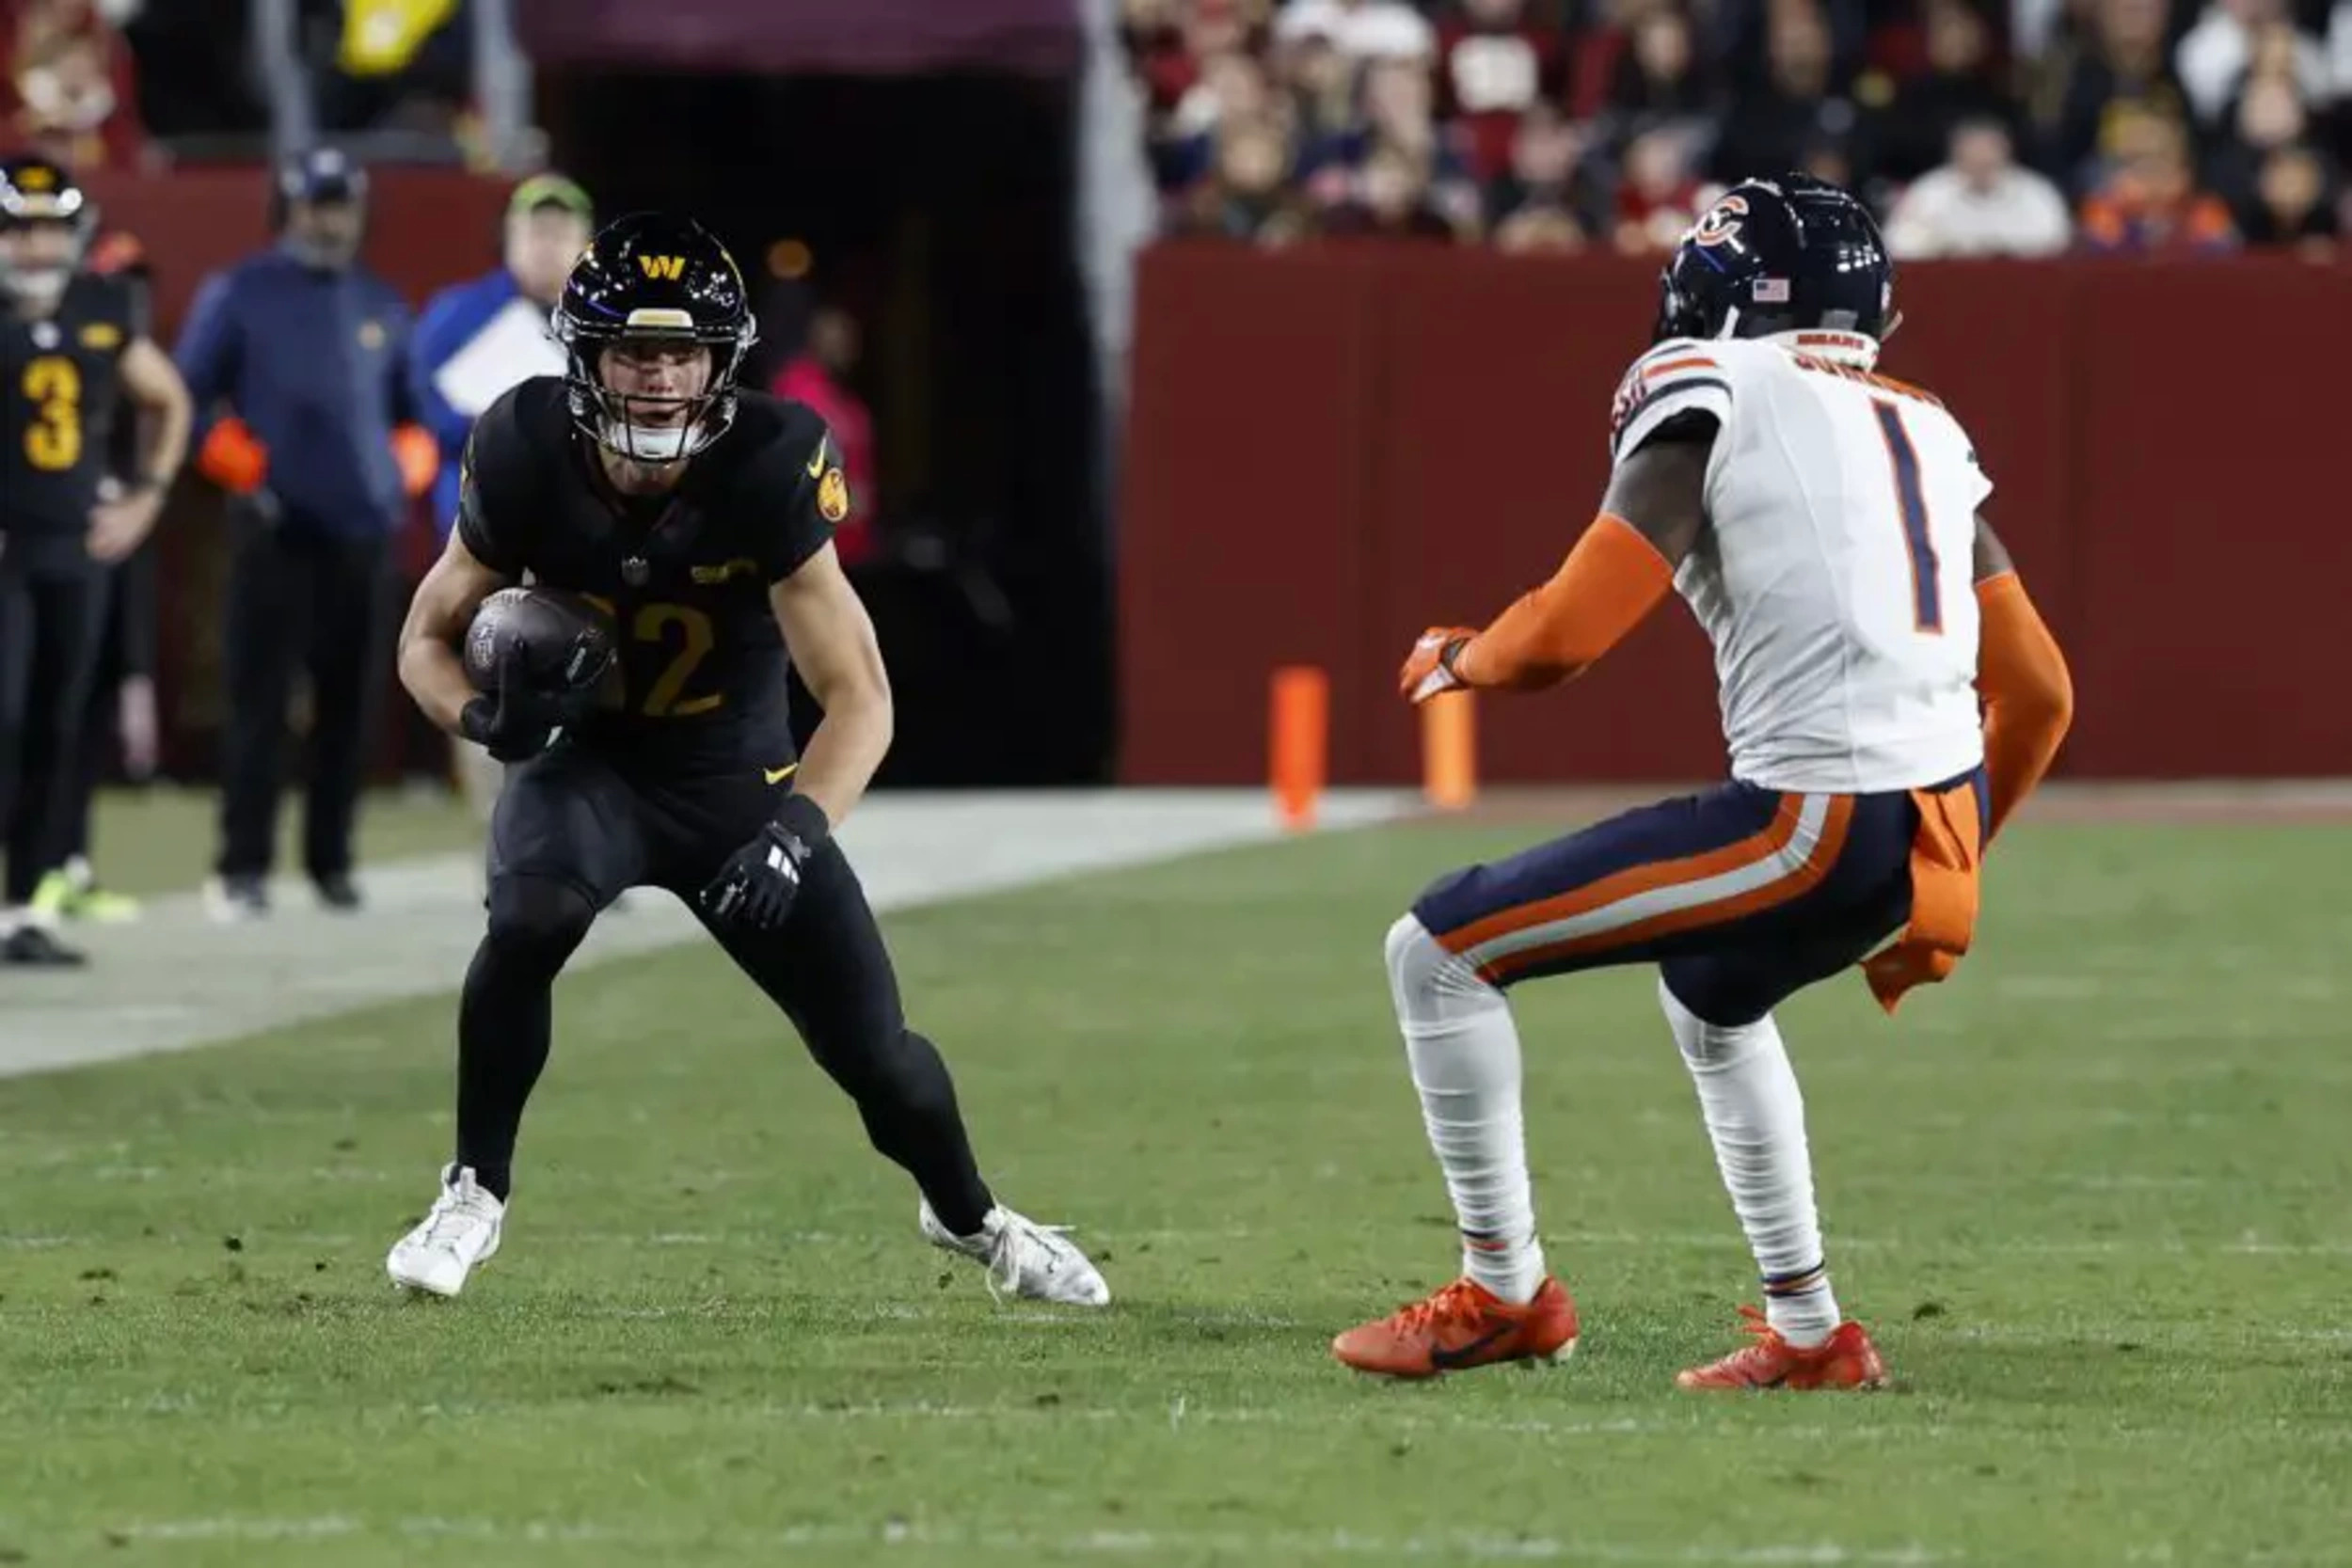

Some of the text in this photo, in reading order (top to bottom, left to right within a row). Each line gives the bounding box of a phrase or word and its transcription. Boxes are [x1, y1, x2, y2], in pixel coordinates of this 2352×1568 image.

[638, 255, 685, 280] W
[22, 356, 82, 471] 3
[1870, 396, 1945, 635] 1
[585, 593, 723, 716] 2
